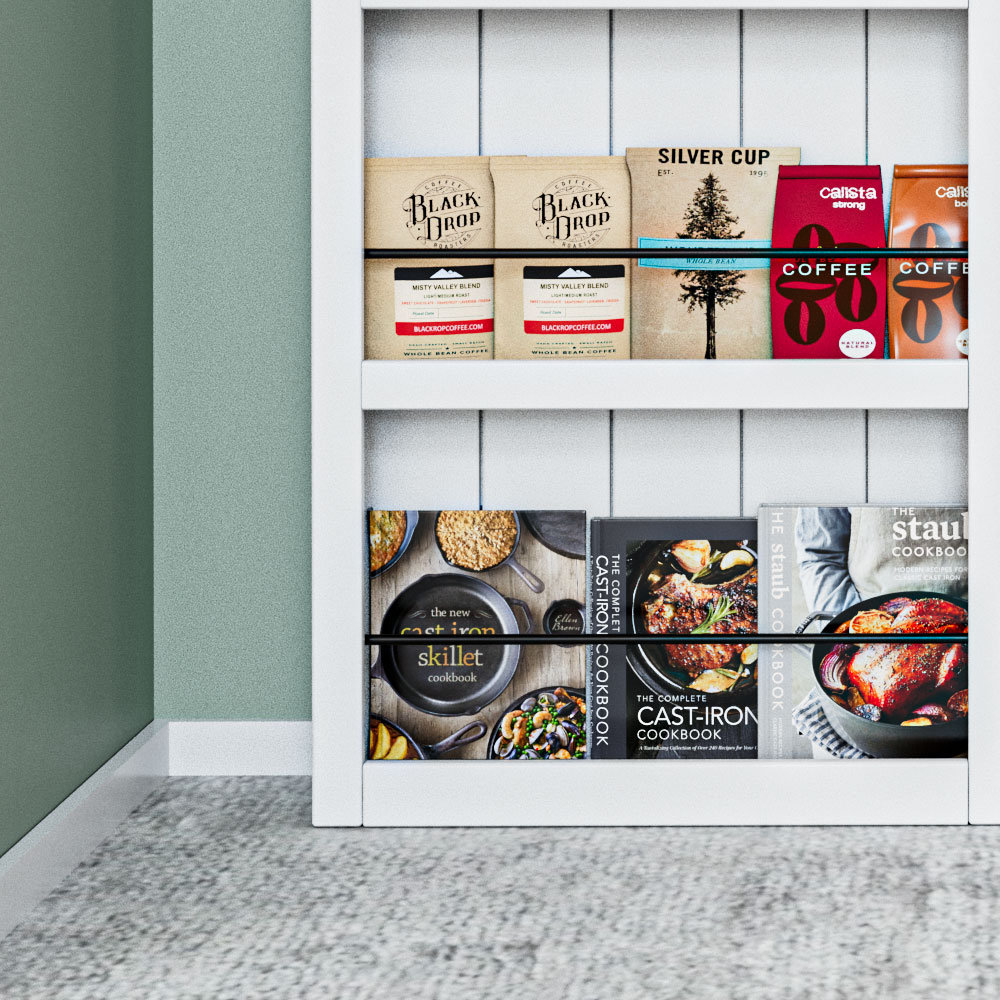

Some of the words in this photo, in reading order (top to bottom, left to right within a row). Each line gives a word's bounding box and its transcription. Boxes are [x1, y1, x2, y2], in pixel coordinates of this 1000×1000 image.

[658, 148, 724, 165] SILVER
[731, 149, 770, 165] CUP
[402, 191, 481, 226] BLACK
[532, 191, 611, 225] BLACK
[832, 201, 866, 210] strong
[418, 211, 481, 241] DROP
[546, 211, 610, 241] DROP
[782, 263, 872, 276] COFFEE
[771, 507, 784, 534] HE
[892, 507, 916, 516] THE
[611, 554, 621, 575] THE
[771, 544, 790, 600] staub
[596, 555, 609, 634] CAST-IRON
[431, 607, 447, 617] the
[449, 609, 470, 617] new
[611, 579, 621, 634] COMPLET
[551, 622, 581, 631] Brown
[554, 613, 578, 623] Ellen
[418, 644, 483, 666] skillet
[771, 608, 784, 711] COKBOOK
[428, 672, 477, 682] cookbook
[596, 644, 609, 746] COOKBOOK
[636, 695, 654, 703] THE
[657, 695, 707, 703] COMPLETE
[636, 728, 722, 740] COOKBOOK
